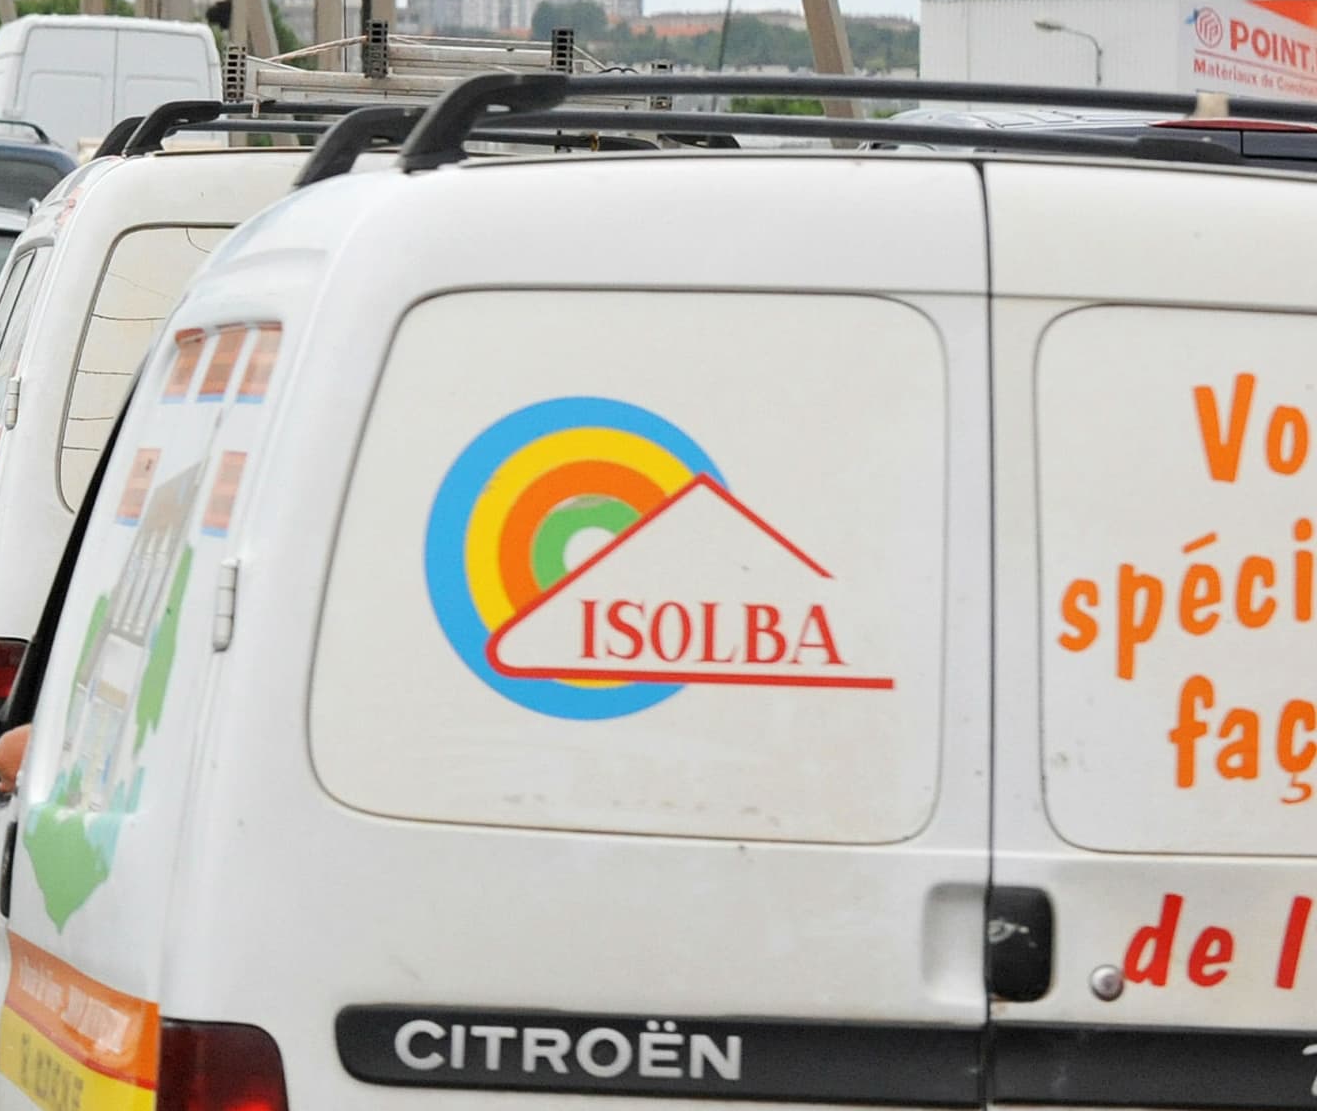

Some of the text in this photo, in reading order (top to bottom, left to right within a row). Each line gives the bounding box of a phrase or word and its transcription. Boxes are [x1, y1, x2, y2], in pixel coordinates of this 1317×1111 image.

[1230, 19, 1317, 73] POINT.
[579, 599, 849, 665] ISOLBA
[1057, 518, 1314, 681] spéci
[1122, 893, 1235, 988] de
[394, 1019, 742, 1081] CITROËN
